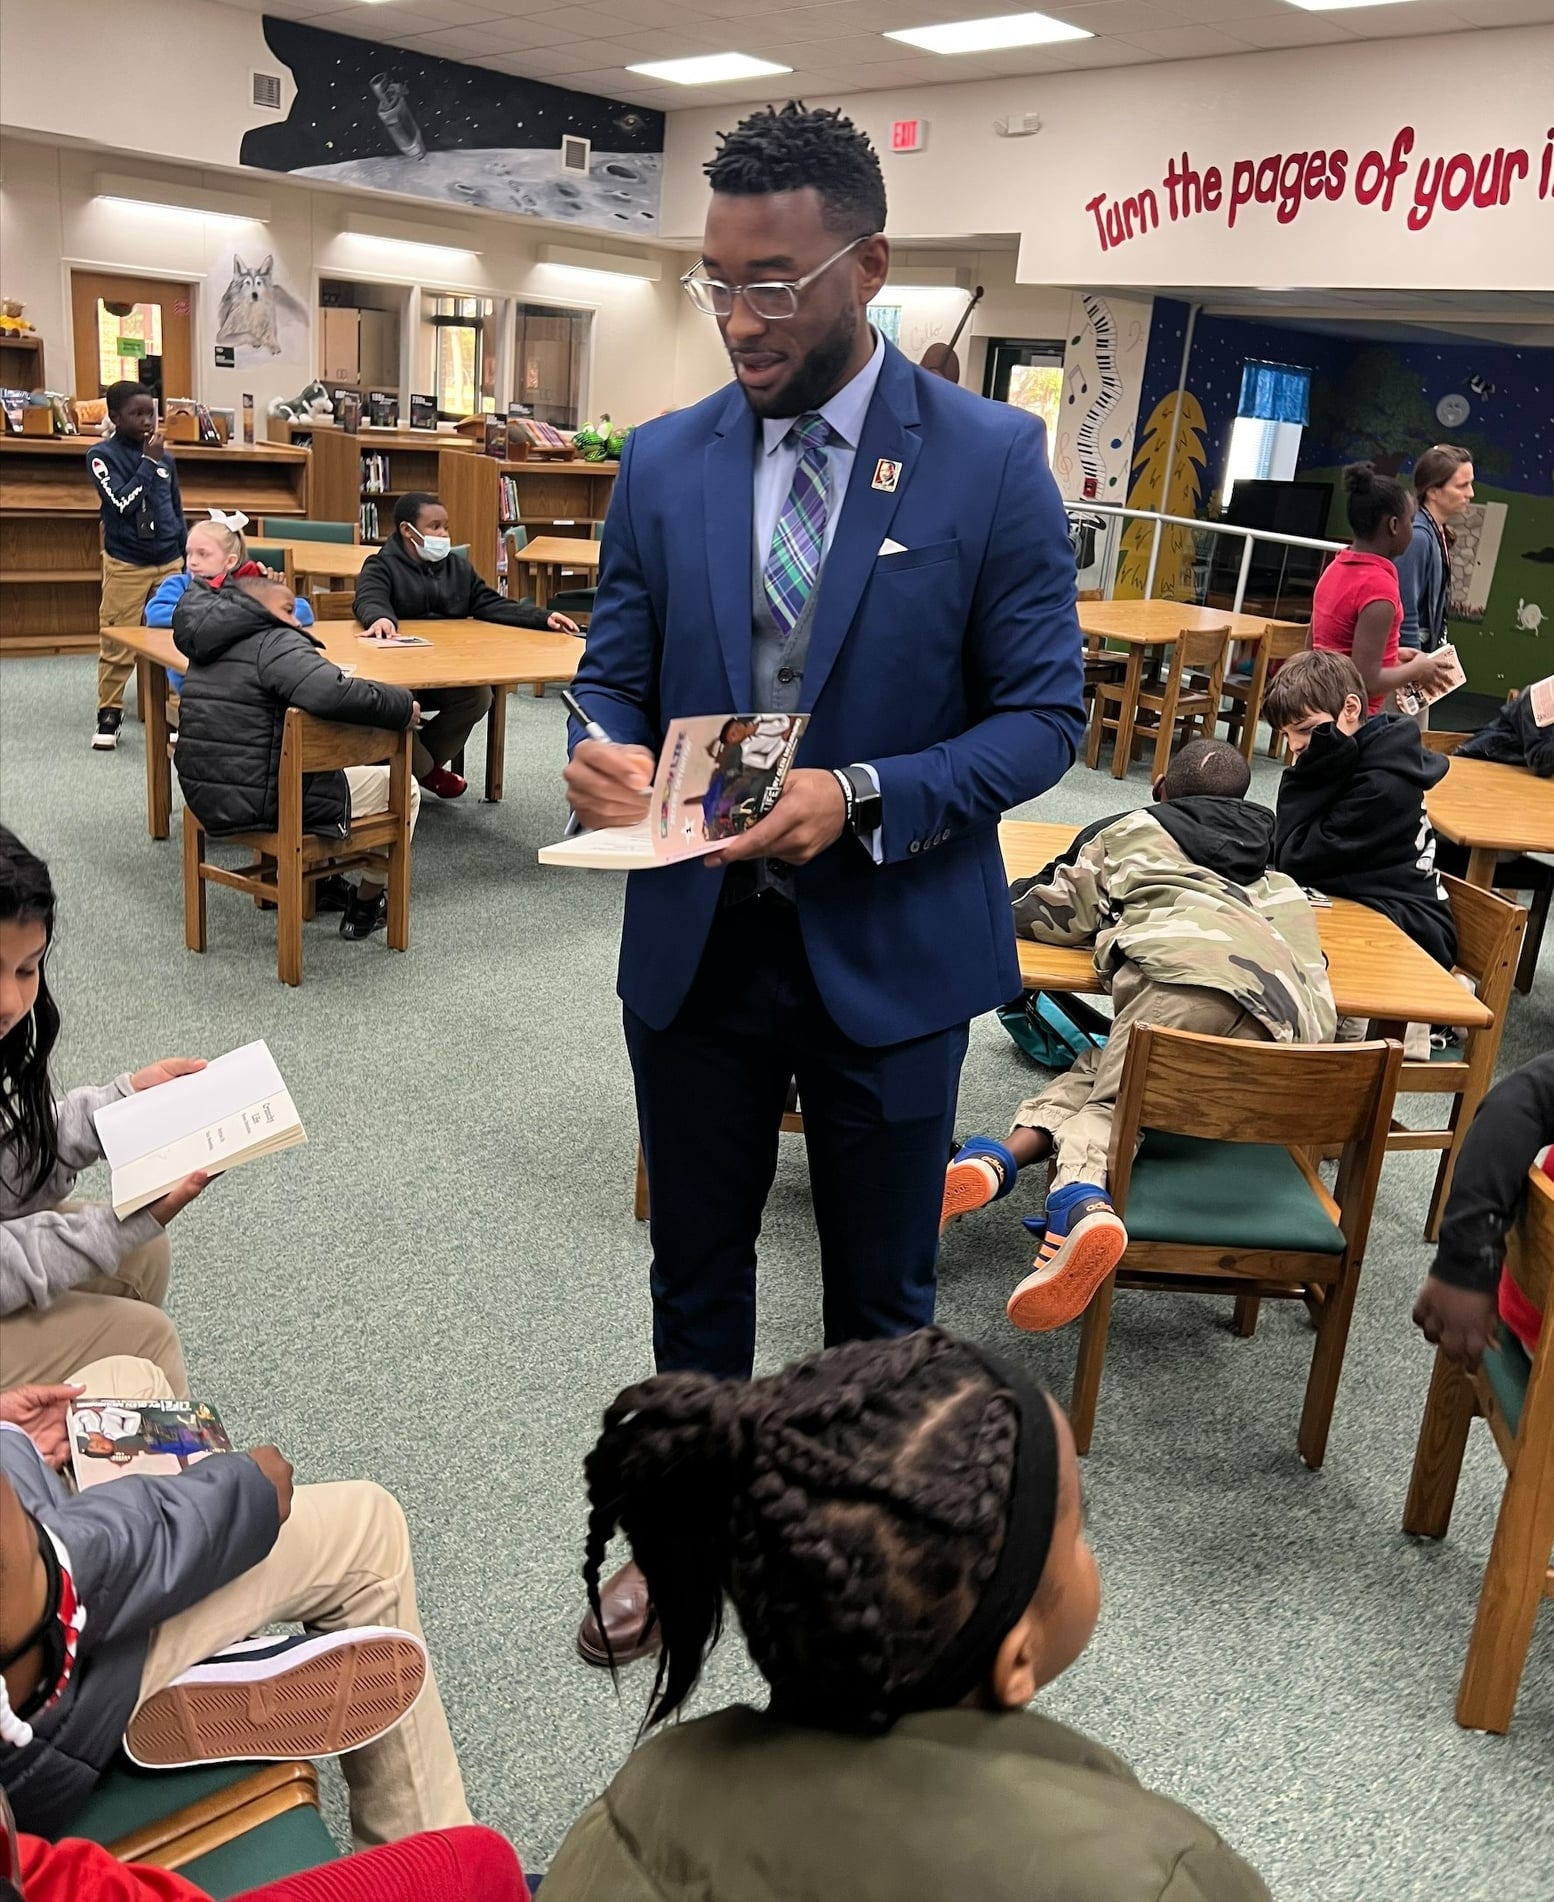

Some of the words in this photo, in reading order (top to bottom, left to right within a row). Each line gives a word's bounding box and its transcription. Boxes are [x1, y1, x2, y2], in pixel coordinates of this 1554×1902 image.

[1085, 192, 1160, 251] Turn
[1163, 151, 1223, 222] the
[1228, 149, 1348, 229] pages
[1354, 126, 1415, 212] of
[1407, 147, 1529, 231] your
[1539, 127, 1554, 200] i
[91, 457, 143, 514] Champion
[763, 788, 780, 811] LIFE
